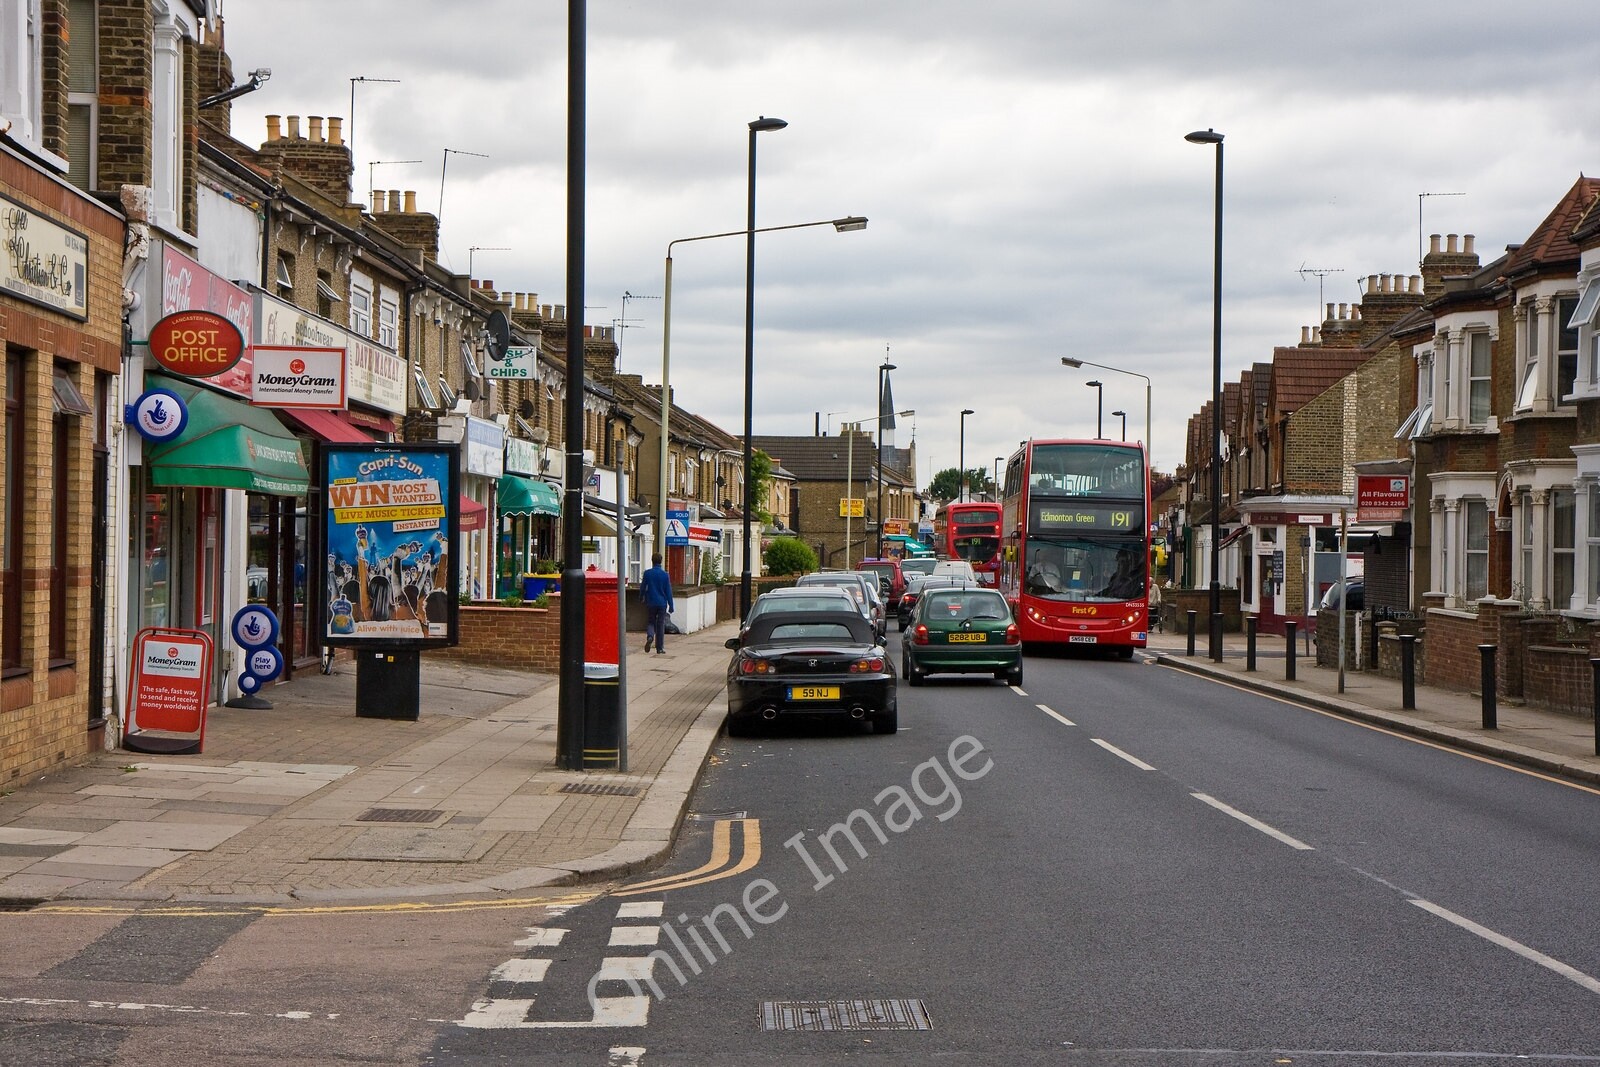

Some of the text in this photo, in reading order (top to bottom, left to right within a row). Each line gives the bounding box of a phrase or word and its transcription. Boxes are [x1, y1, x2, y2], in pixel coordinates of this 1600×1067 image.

[171, 316, 220, 326] LANCASTER ROAD
[171, 330, 219, 345] POST
[164, 347, 228, 362] OFFICE
[504, 358, 513, 367] &
[490, 368, 528, 377] CHIPS
[257, 373, 336, 387] MoneyGram
[358, 455, 424, 475] Capri-Sun
[392, 483, 428, 494] MOST
[329, 483, 390, 508] WIN
[393, 493, 436, 504] WANTED
[340, 507, 442, 520] LIVE MUSIC TICKETS
[1041, 511, 1129, 526] Edmonton Green 191
[396, 520, 438, 531] INSTANTLY
[1072, 606, 1087, 614] First
[356, 624, 420, 633] Alive with juice
[147, 656, 196, 666] MoneyGram
[155, 686, 170, 694] safe,
[802, 688, 829, 698] 59 NJ
[163, 703, 197, 711] worldwide
